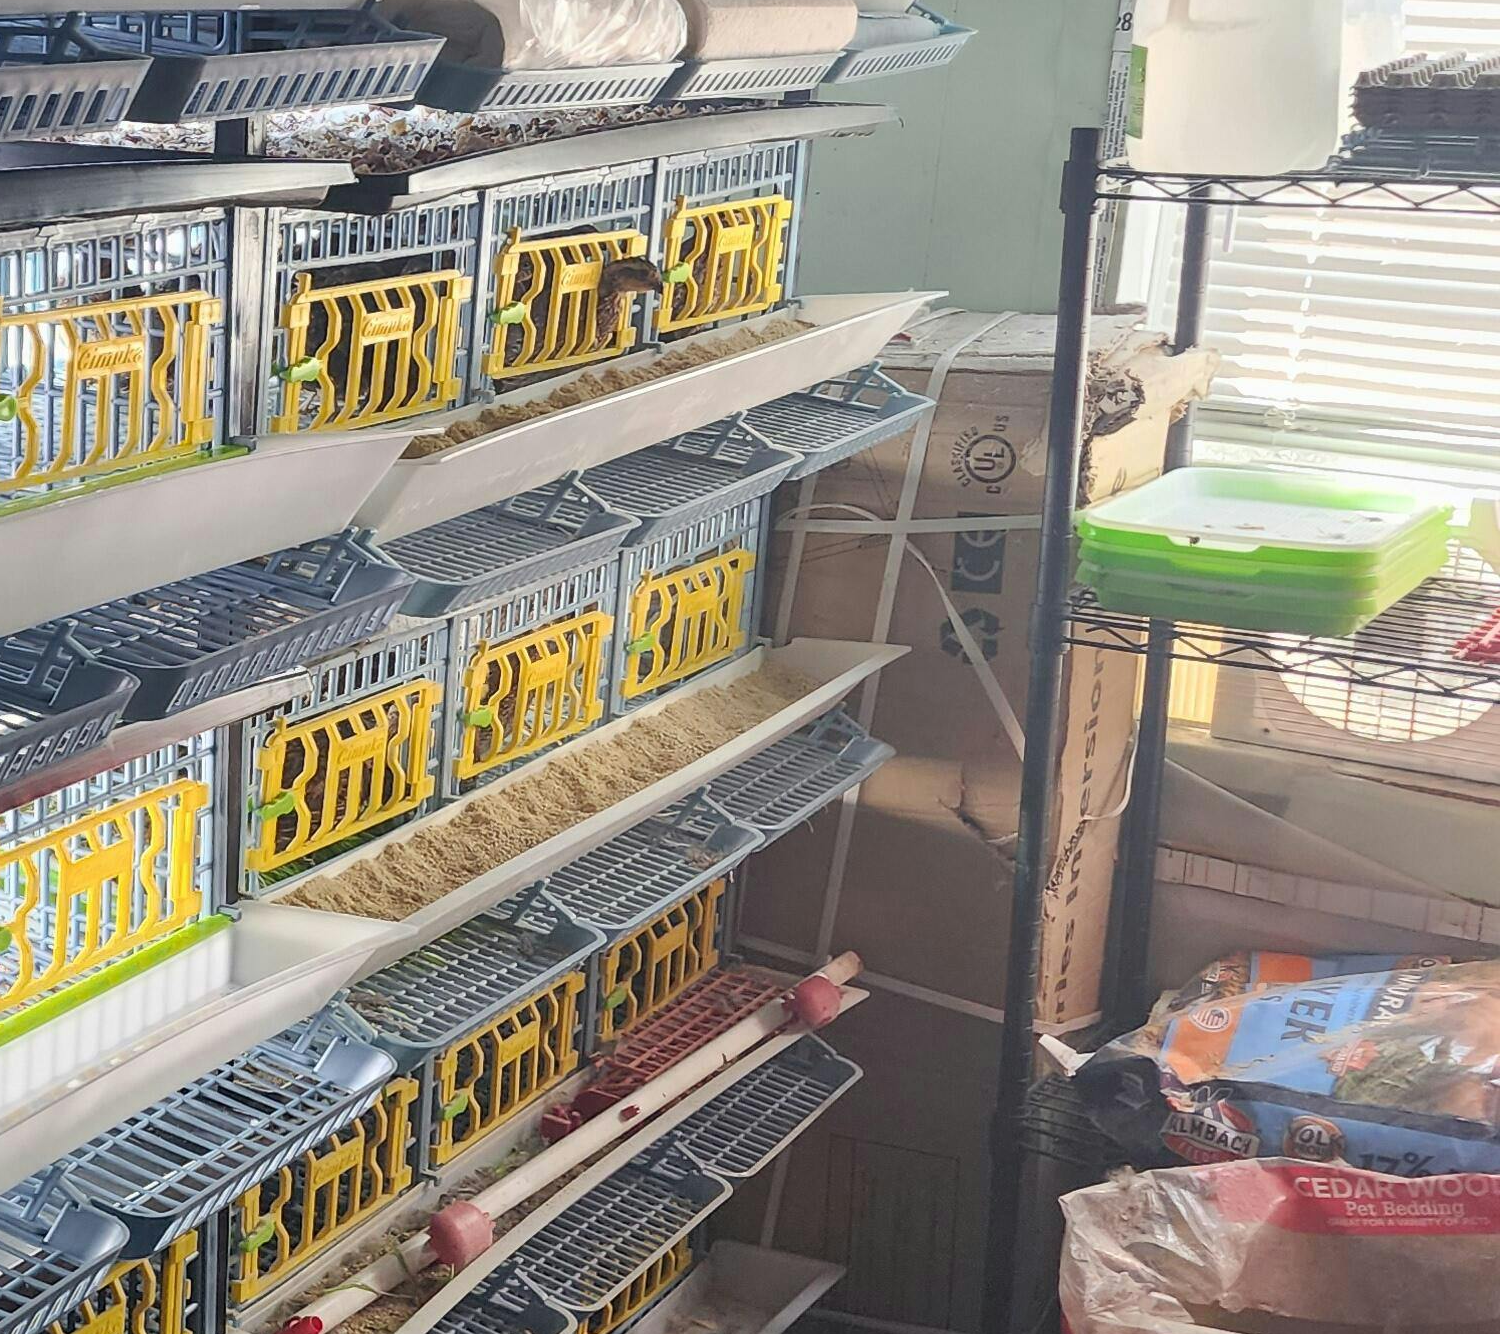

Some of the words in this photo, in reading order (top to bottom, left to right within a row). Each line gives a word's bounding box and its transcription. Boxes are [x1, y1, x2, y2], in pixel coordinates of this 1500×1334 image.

[77, 343, 143, 371] Cimuka
[1054, 919, 1075, 1024] ries
[1294, 1176, 1395, 1199] CEDAR
[1346, 1201, 1376, 1216] Pet
[1383, 1202, 1466, 1217] Bedding
